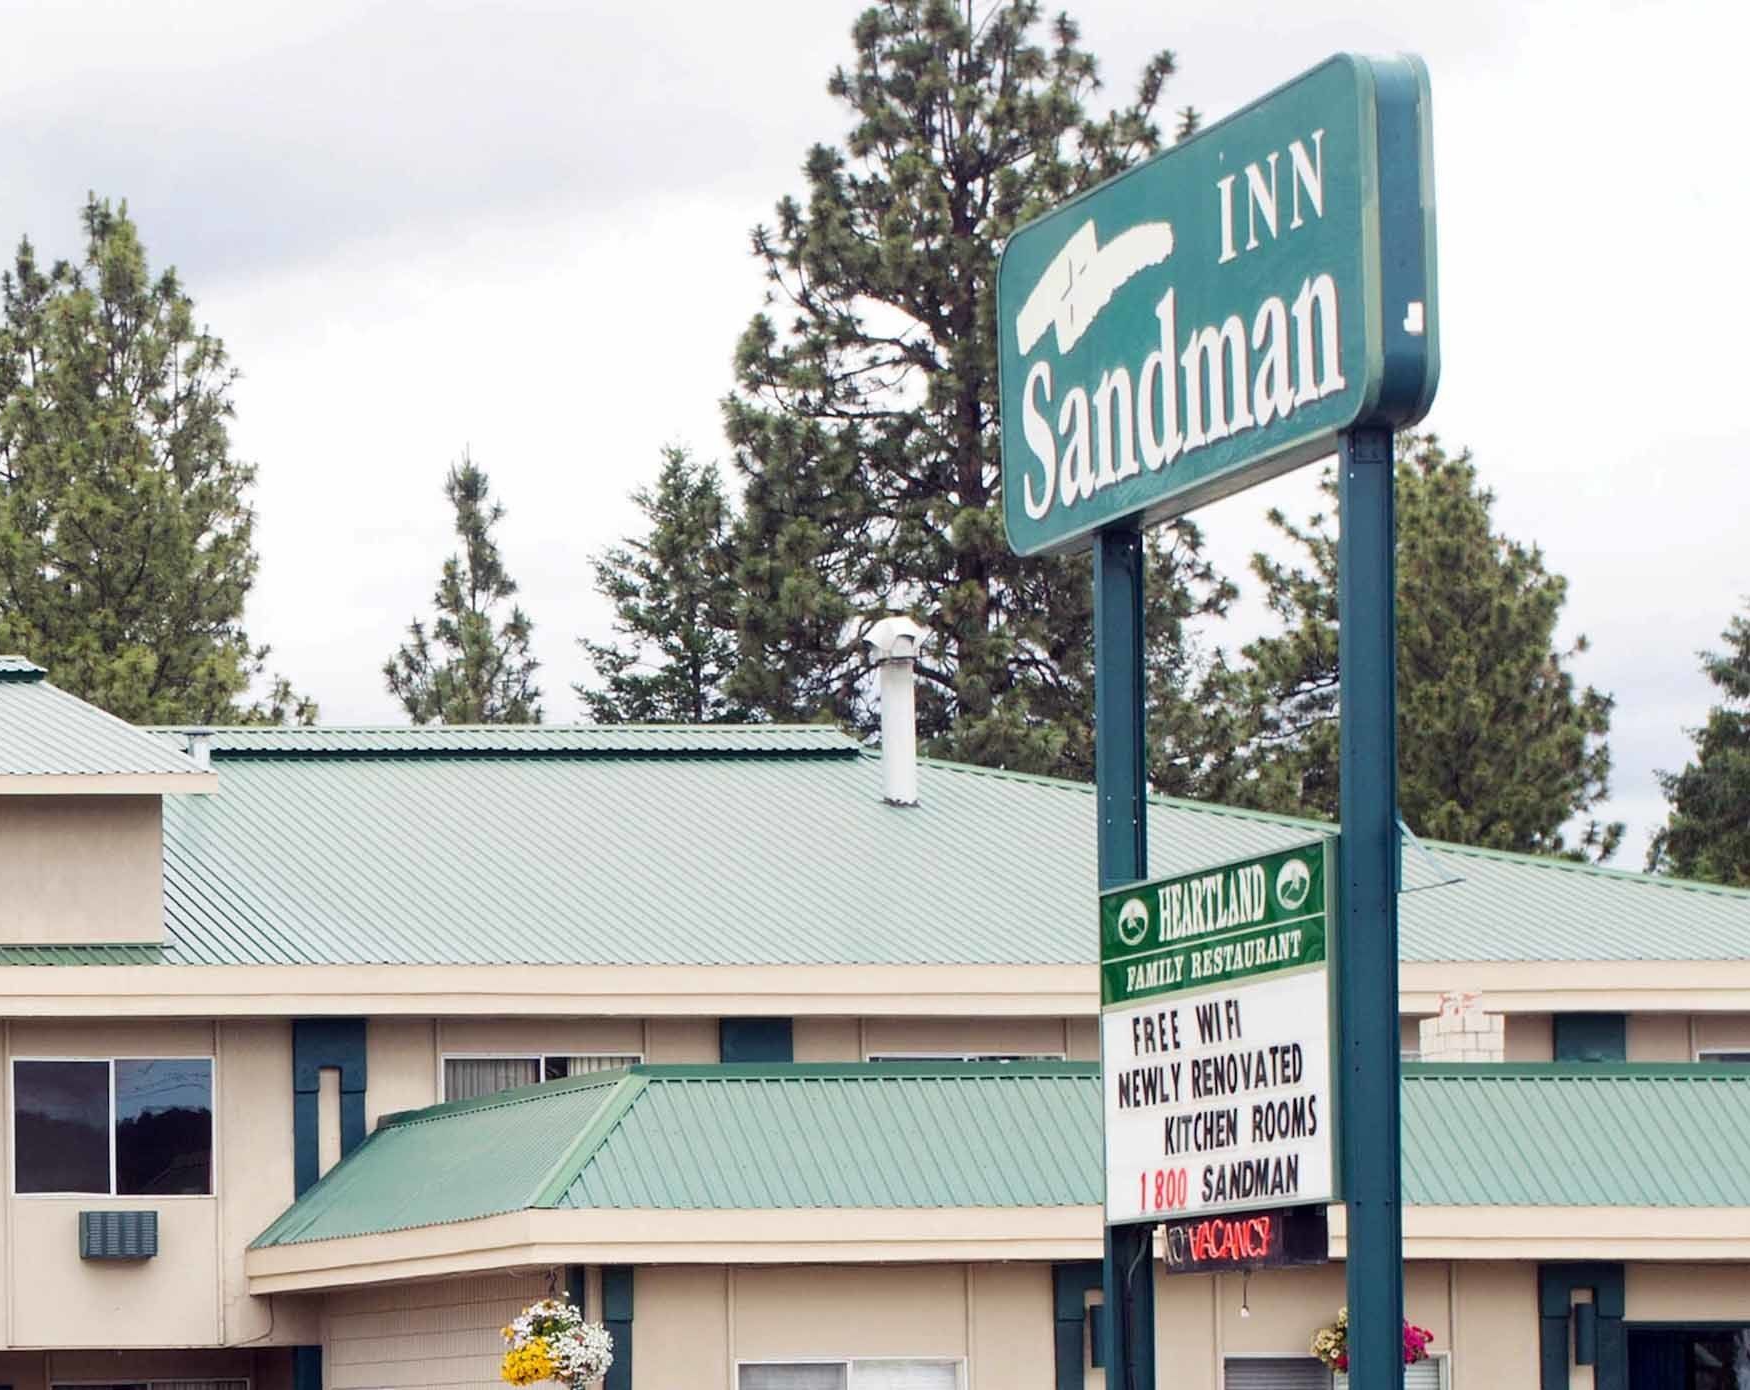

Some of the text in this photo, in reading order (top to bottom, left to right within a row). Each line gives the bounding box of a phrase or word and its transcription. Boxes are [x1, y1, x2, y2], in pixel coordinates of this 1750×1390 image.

[1217, 128, 1325, 265] INN
[1022, 273, 1346, 520] Sandman
[1157, 863, 1267, 943] HEARTLAND
[1126, 929, 1303, 993] FAMILY RESTAURANT
[1131, 1010, 1181, 1056] FREE
[1118, 1043, 1303, 1109] NEWLY RENOVATED
[1164, 1095, 1317, 1156] KITCHEN ROOMS
[1154, 1168, 1188, 1210] 800
[1201, 1154, 1299, 1203] SANDMAN
[1188, 1215, 1272, 1261] VACANCY
